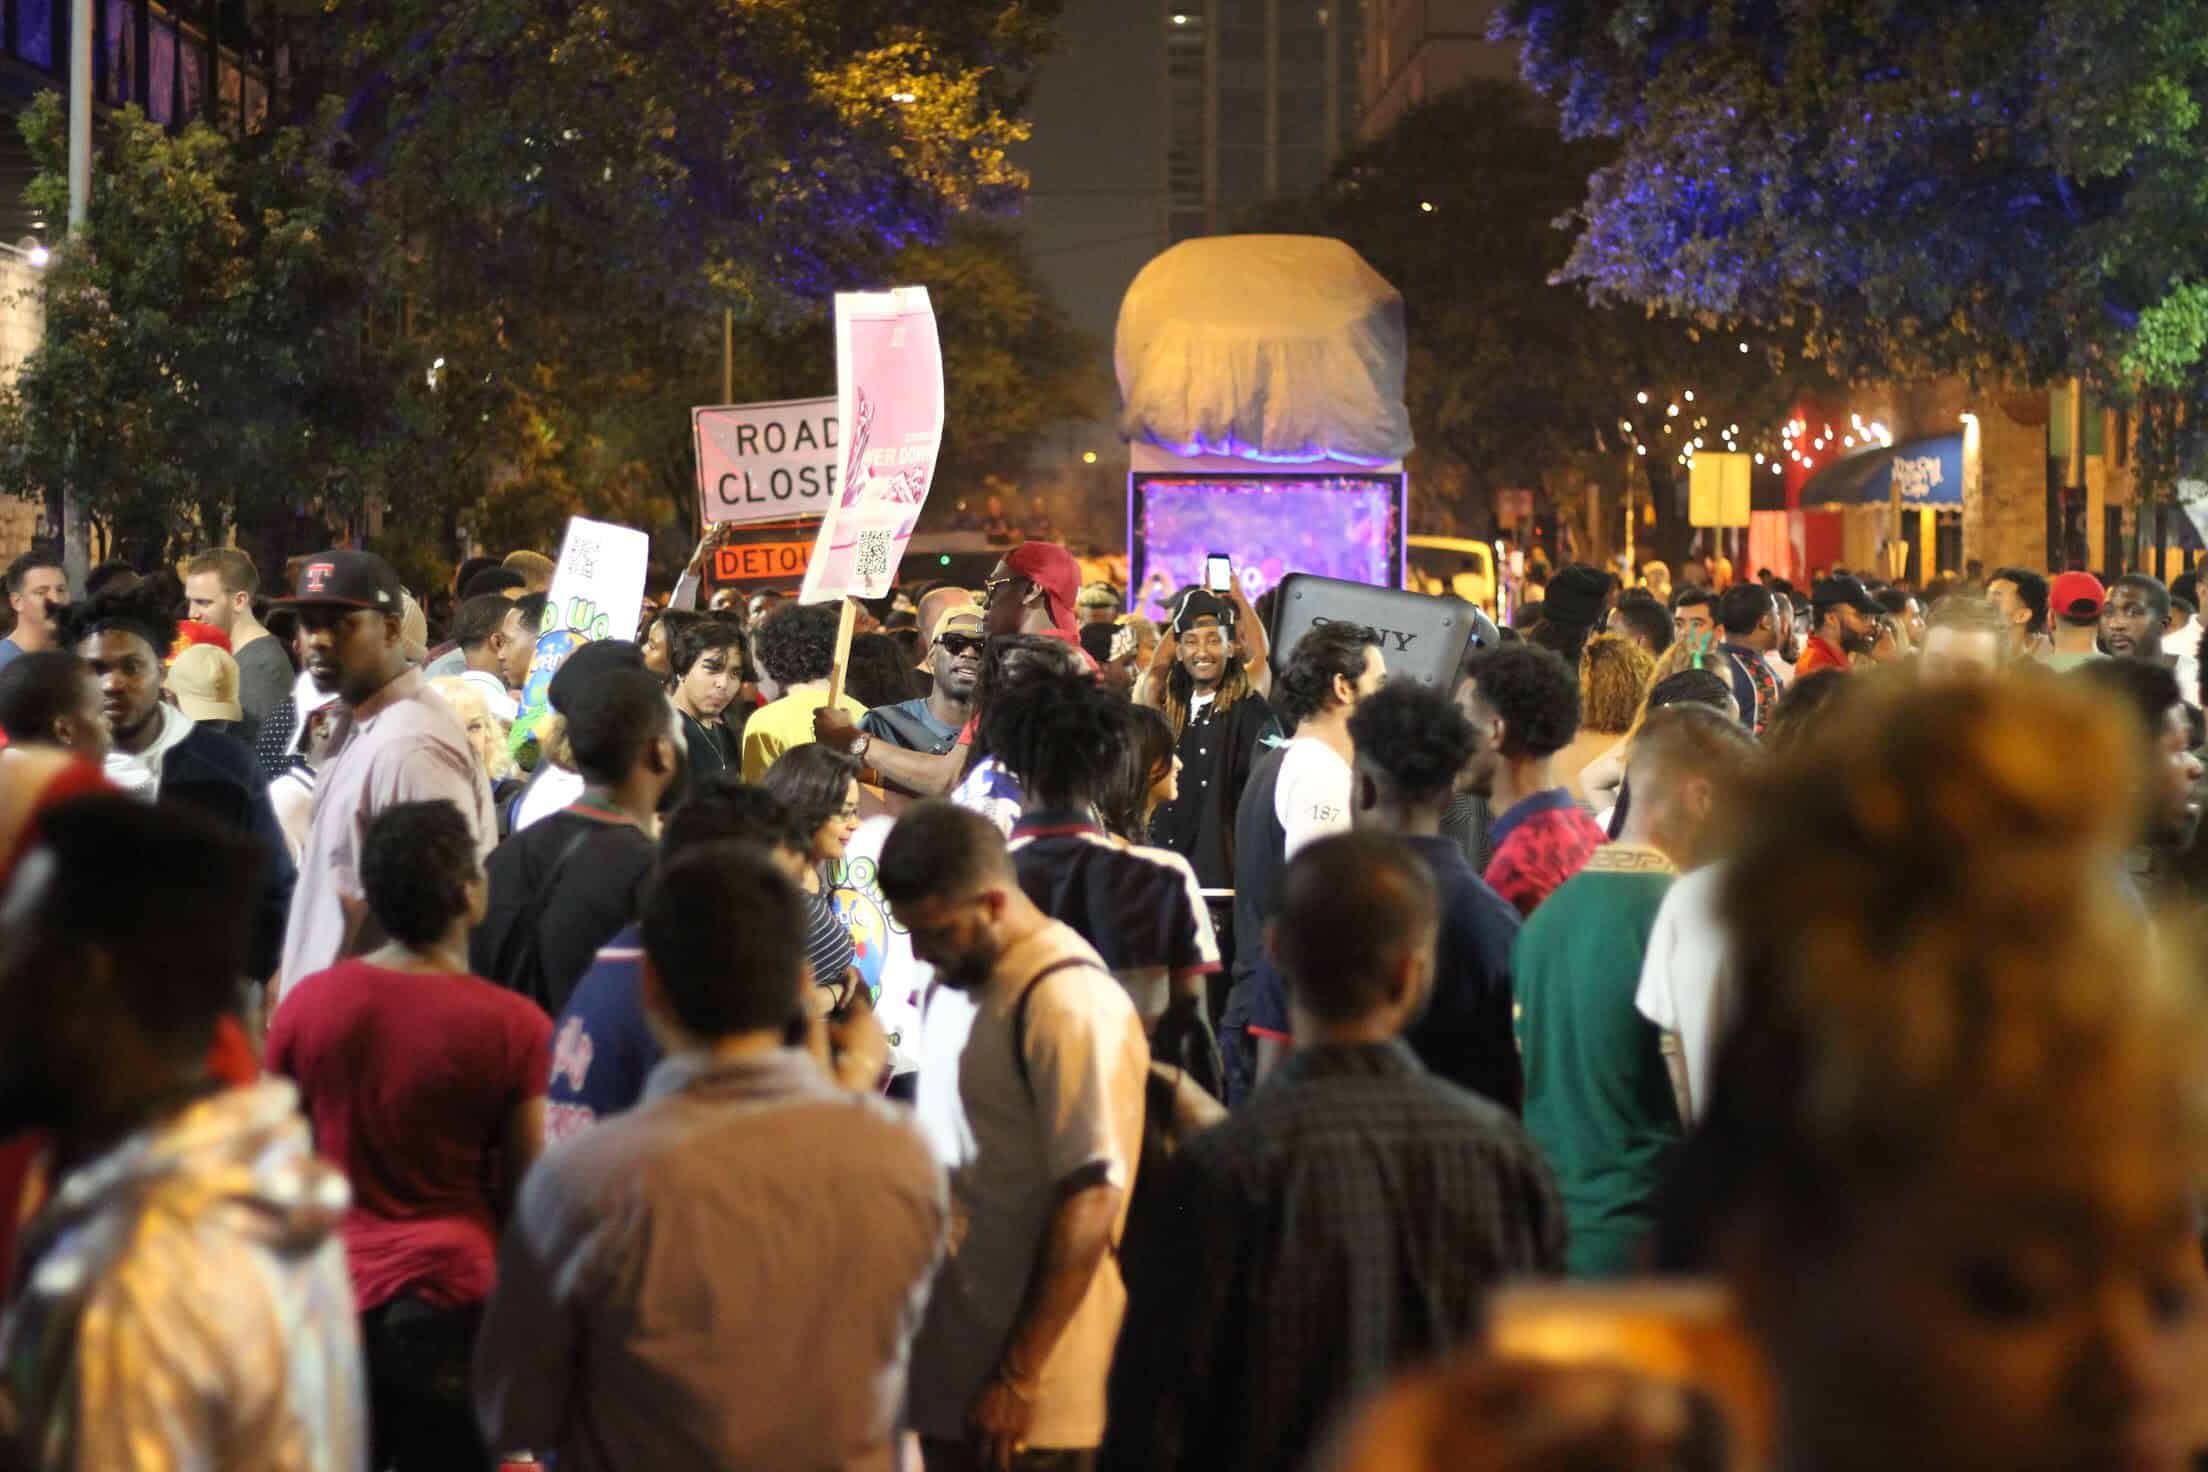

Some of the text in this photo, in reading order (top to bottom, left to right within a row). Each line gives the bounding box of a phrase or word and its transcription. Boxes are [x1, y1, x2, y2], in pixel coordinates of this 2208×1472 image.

[719, 464, 837, 505] CLOS
[721, 547, 809, 575] DETO
[306, 563, 335, 592] T
[1312, 804, 1341, 822] 187
